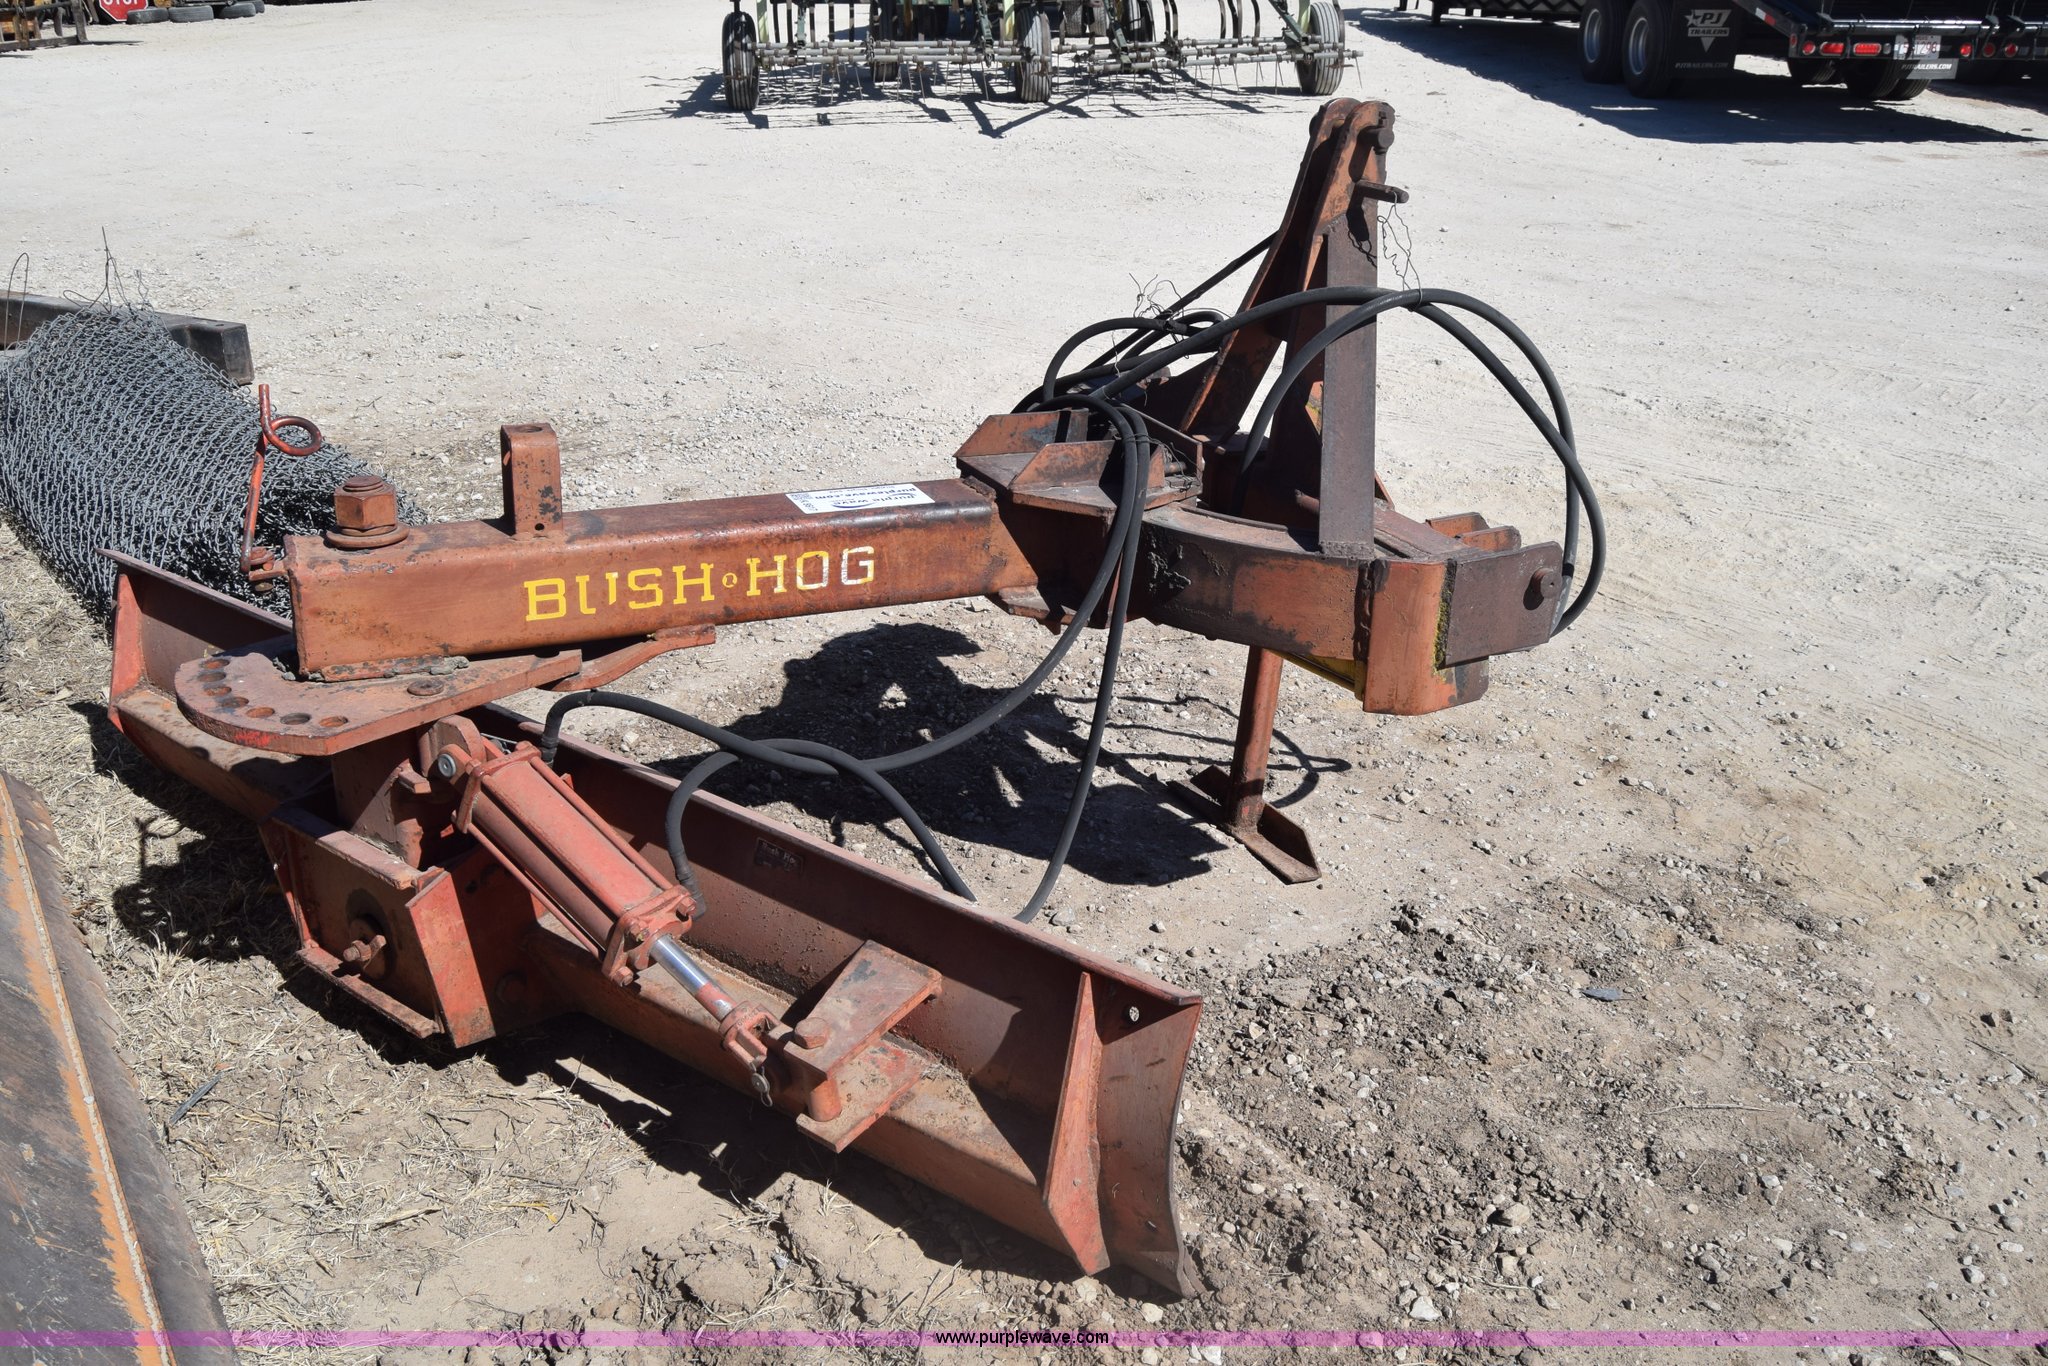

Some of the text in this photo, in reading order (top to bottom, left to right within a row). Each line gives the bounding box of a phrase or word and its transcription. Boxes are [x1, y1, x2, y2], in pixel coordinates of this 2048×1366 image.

[1700, 12, 1723, 24] PJ
[524, 545, 875, 622] BUSH HOG
